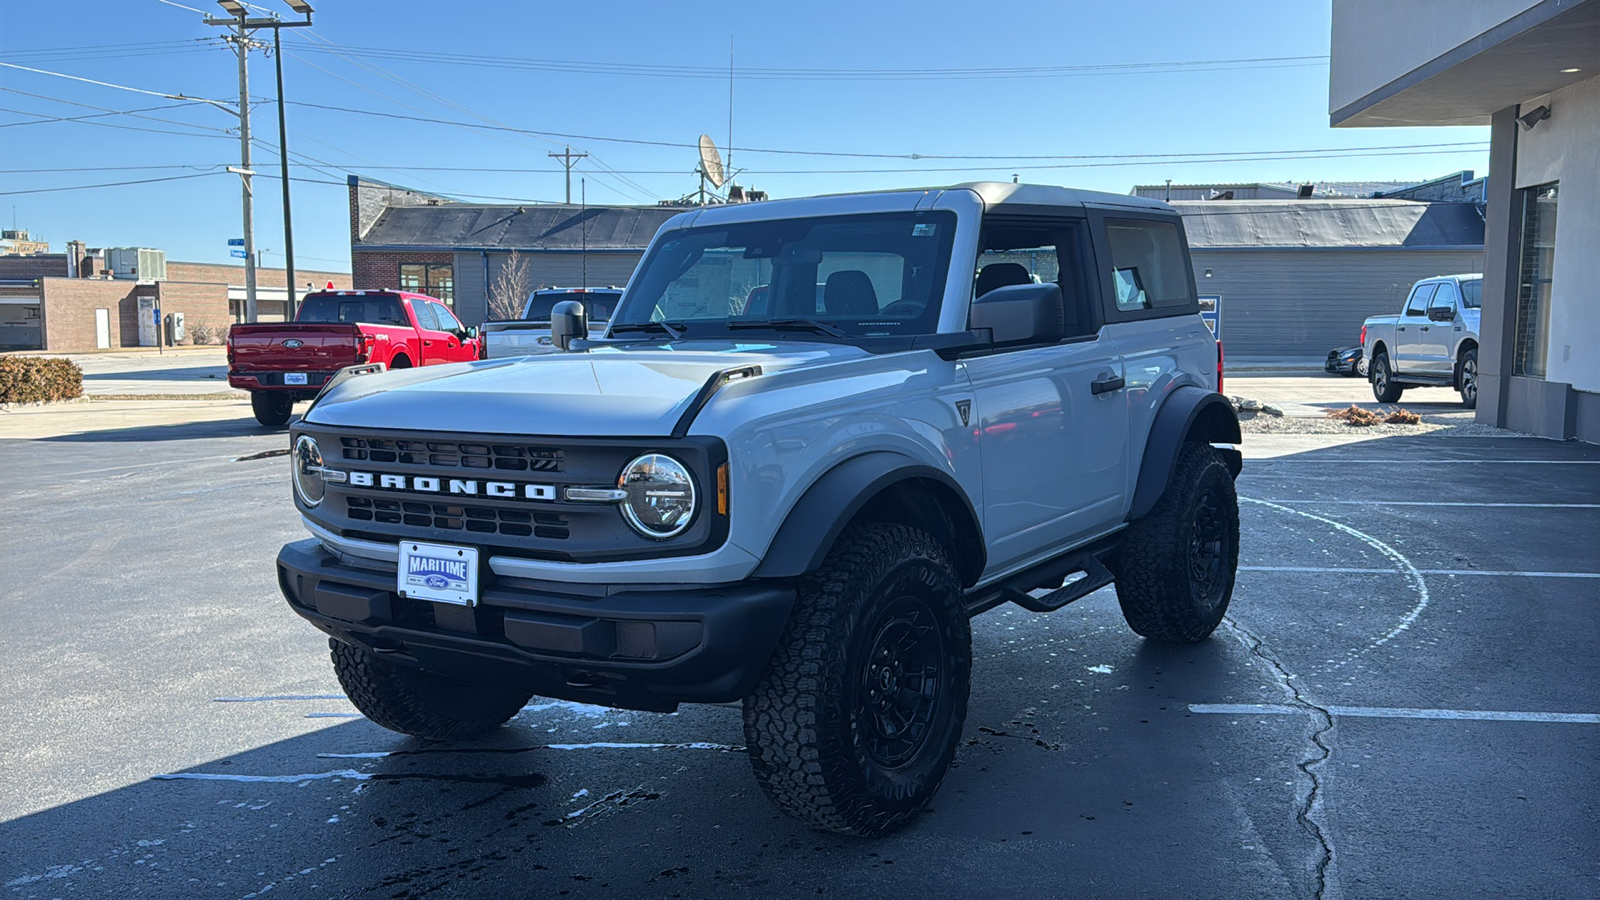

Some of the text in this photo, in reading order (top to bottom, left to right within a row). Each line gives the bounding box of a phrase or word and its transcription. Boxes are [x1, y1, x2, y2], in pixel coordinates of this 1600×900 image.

[350, 471, 556, 500] BRONCO
[410, 556, 466, 580] MARITIME
[428, 576, 447, 588] Ford
